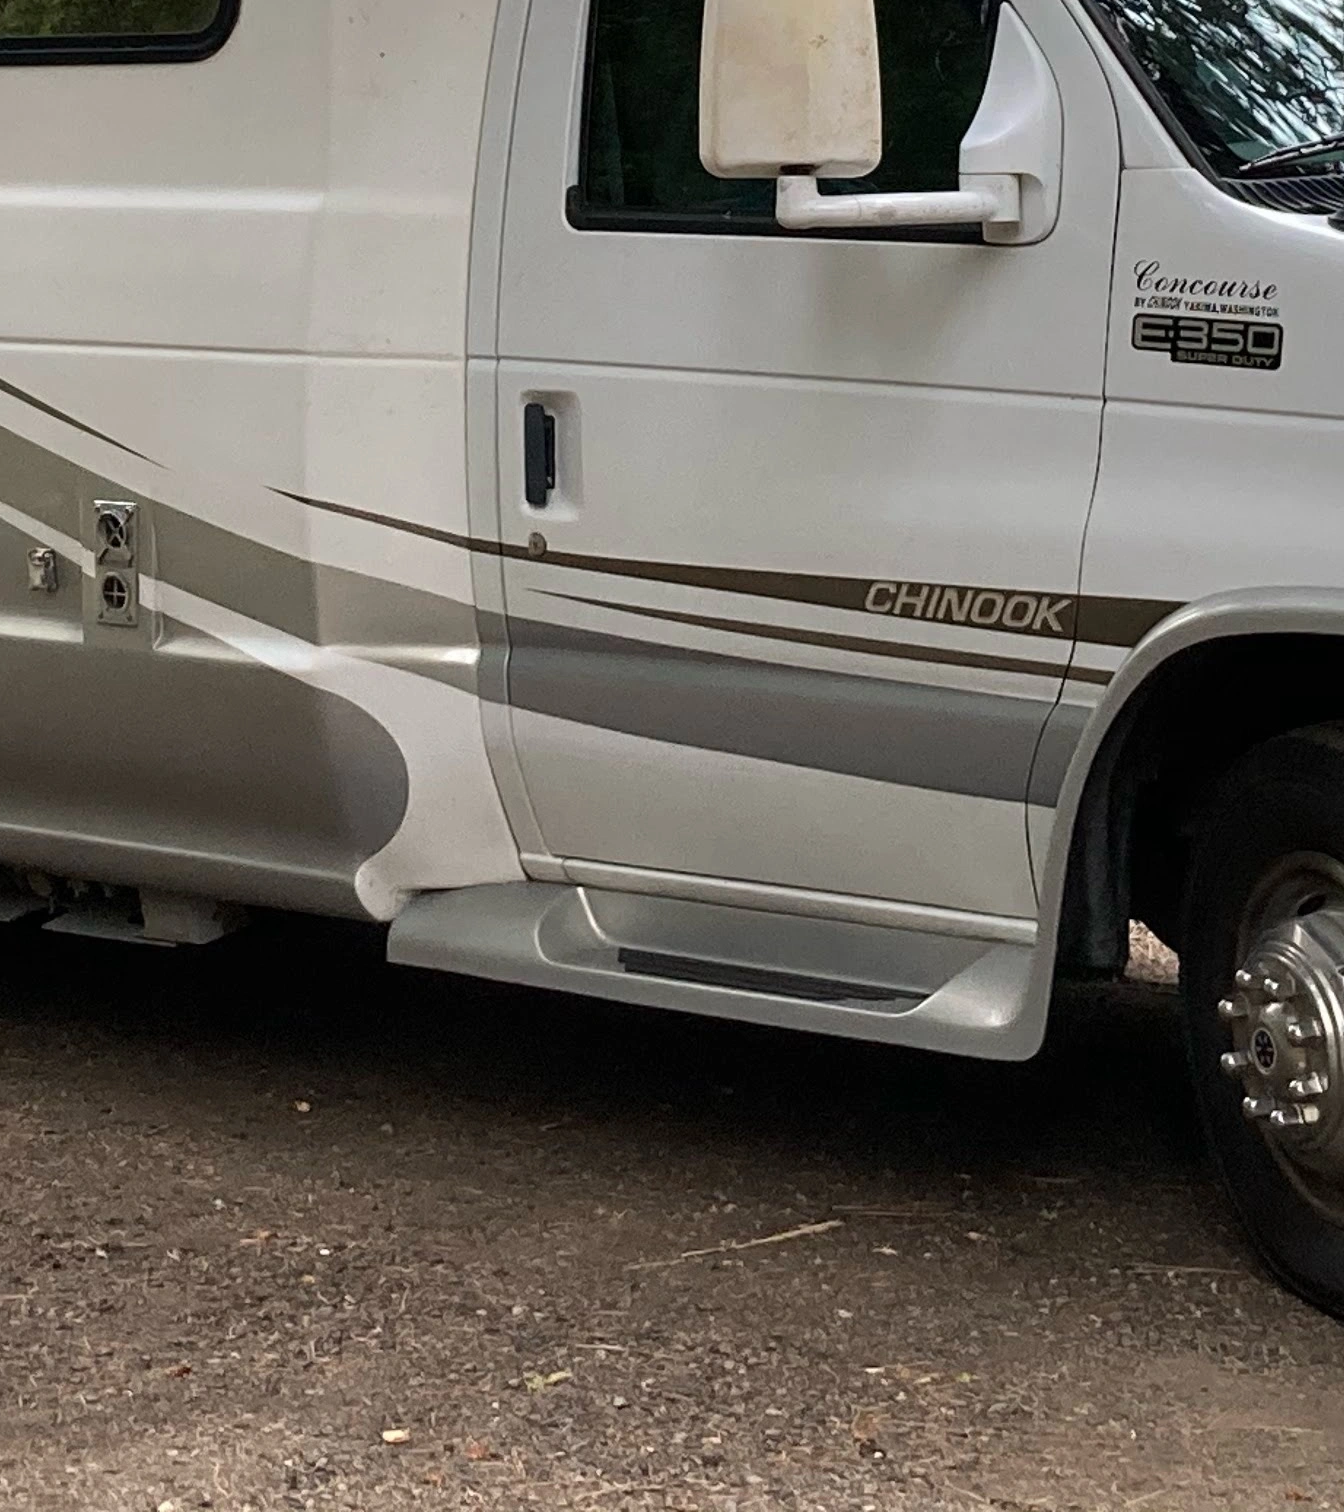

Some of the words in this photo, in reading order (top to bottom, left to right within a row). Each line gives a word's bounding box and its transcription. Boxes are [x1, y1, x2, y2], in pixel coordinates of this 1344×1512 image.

[1133, 259, 1279, 300] Concourse
[1176, 350, 1228, 365] SUPER
[1231, 353, 1275, 368] DUTY
[863, 581, 1073, 633] CHINOOK
